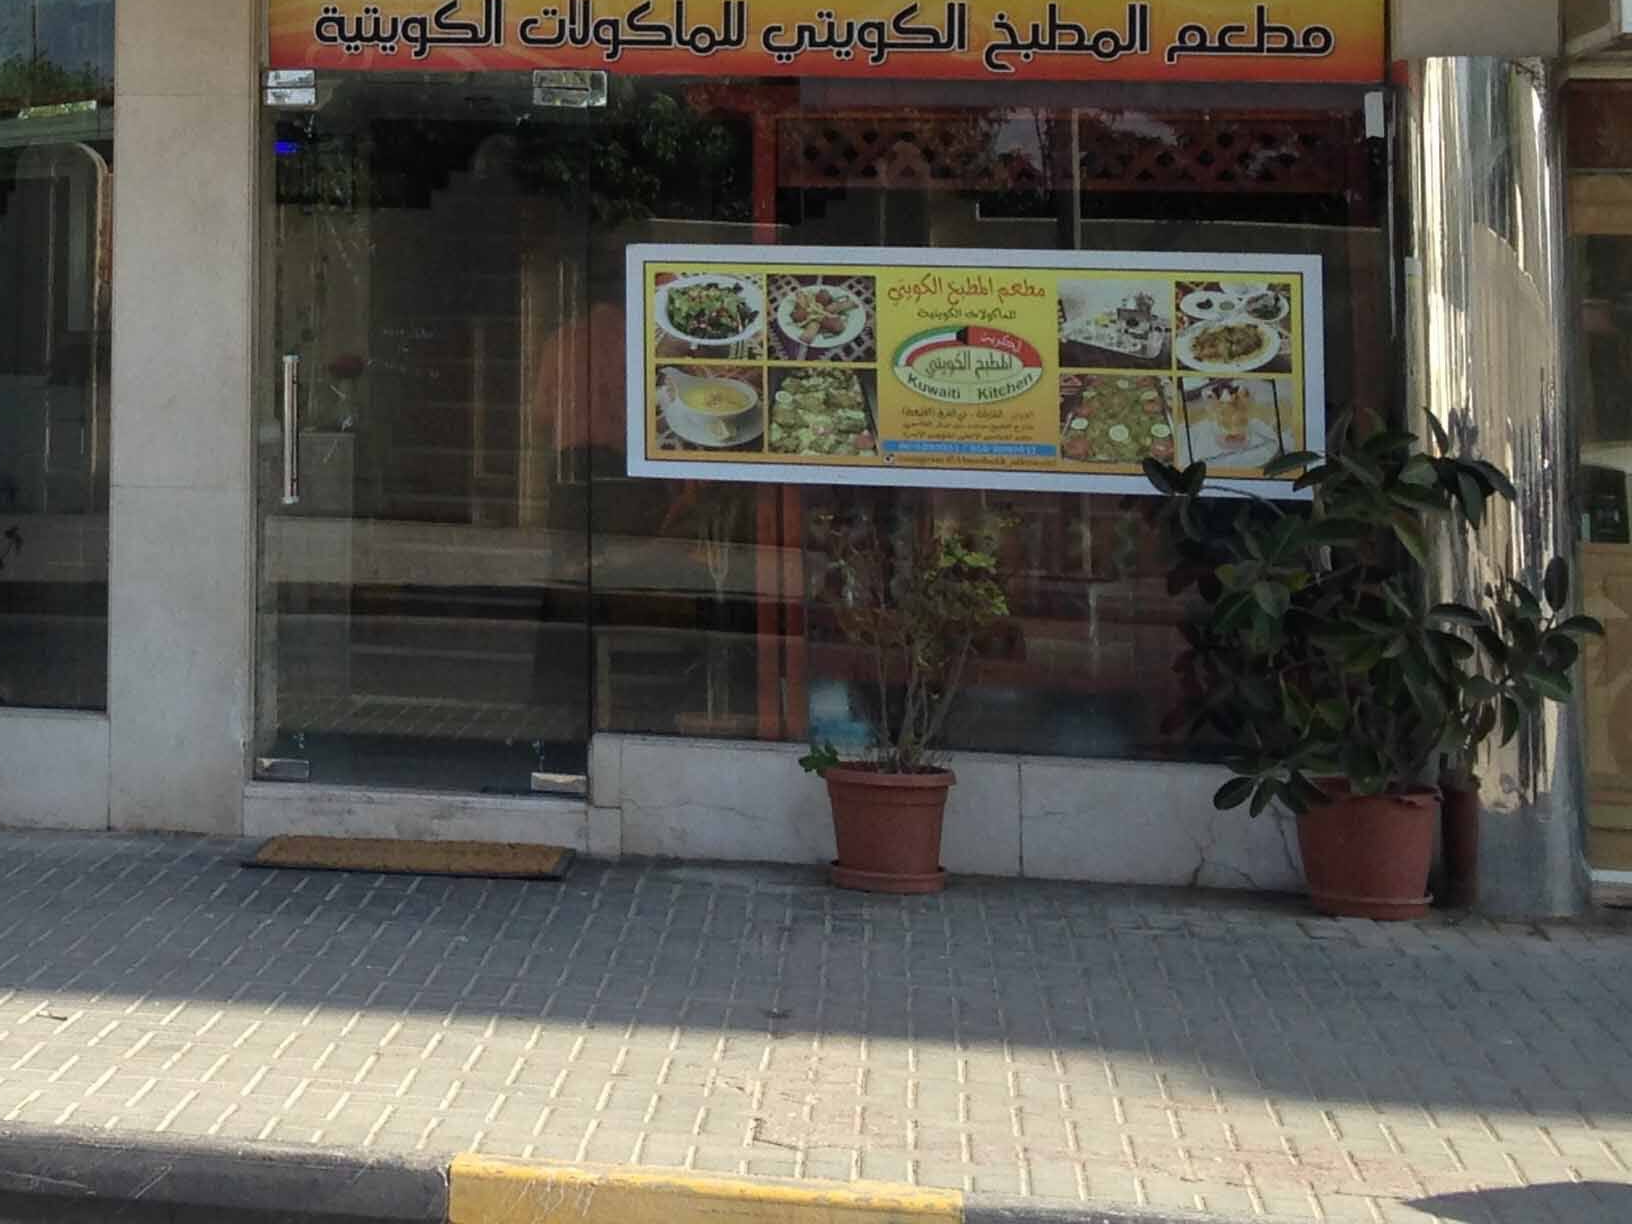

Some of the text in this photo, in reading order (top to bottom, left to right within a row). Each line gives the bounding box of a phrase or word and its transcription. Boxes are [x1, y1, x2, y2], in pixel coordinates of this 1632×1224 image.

[761, 1, 968, 64] الكويتي
[981, 1, 1150, 73] المطبخ
[1164, 3, 1334, 64] مطعم
[946, 274, 993, 306] المطبخ
[996, 278, 1047, 304] مطعم
[905, 371, 1035, 402] Kuwaiti Kitchen
